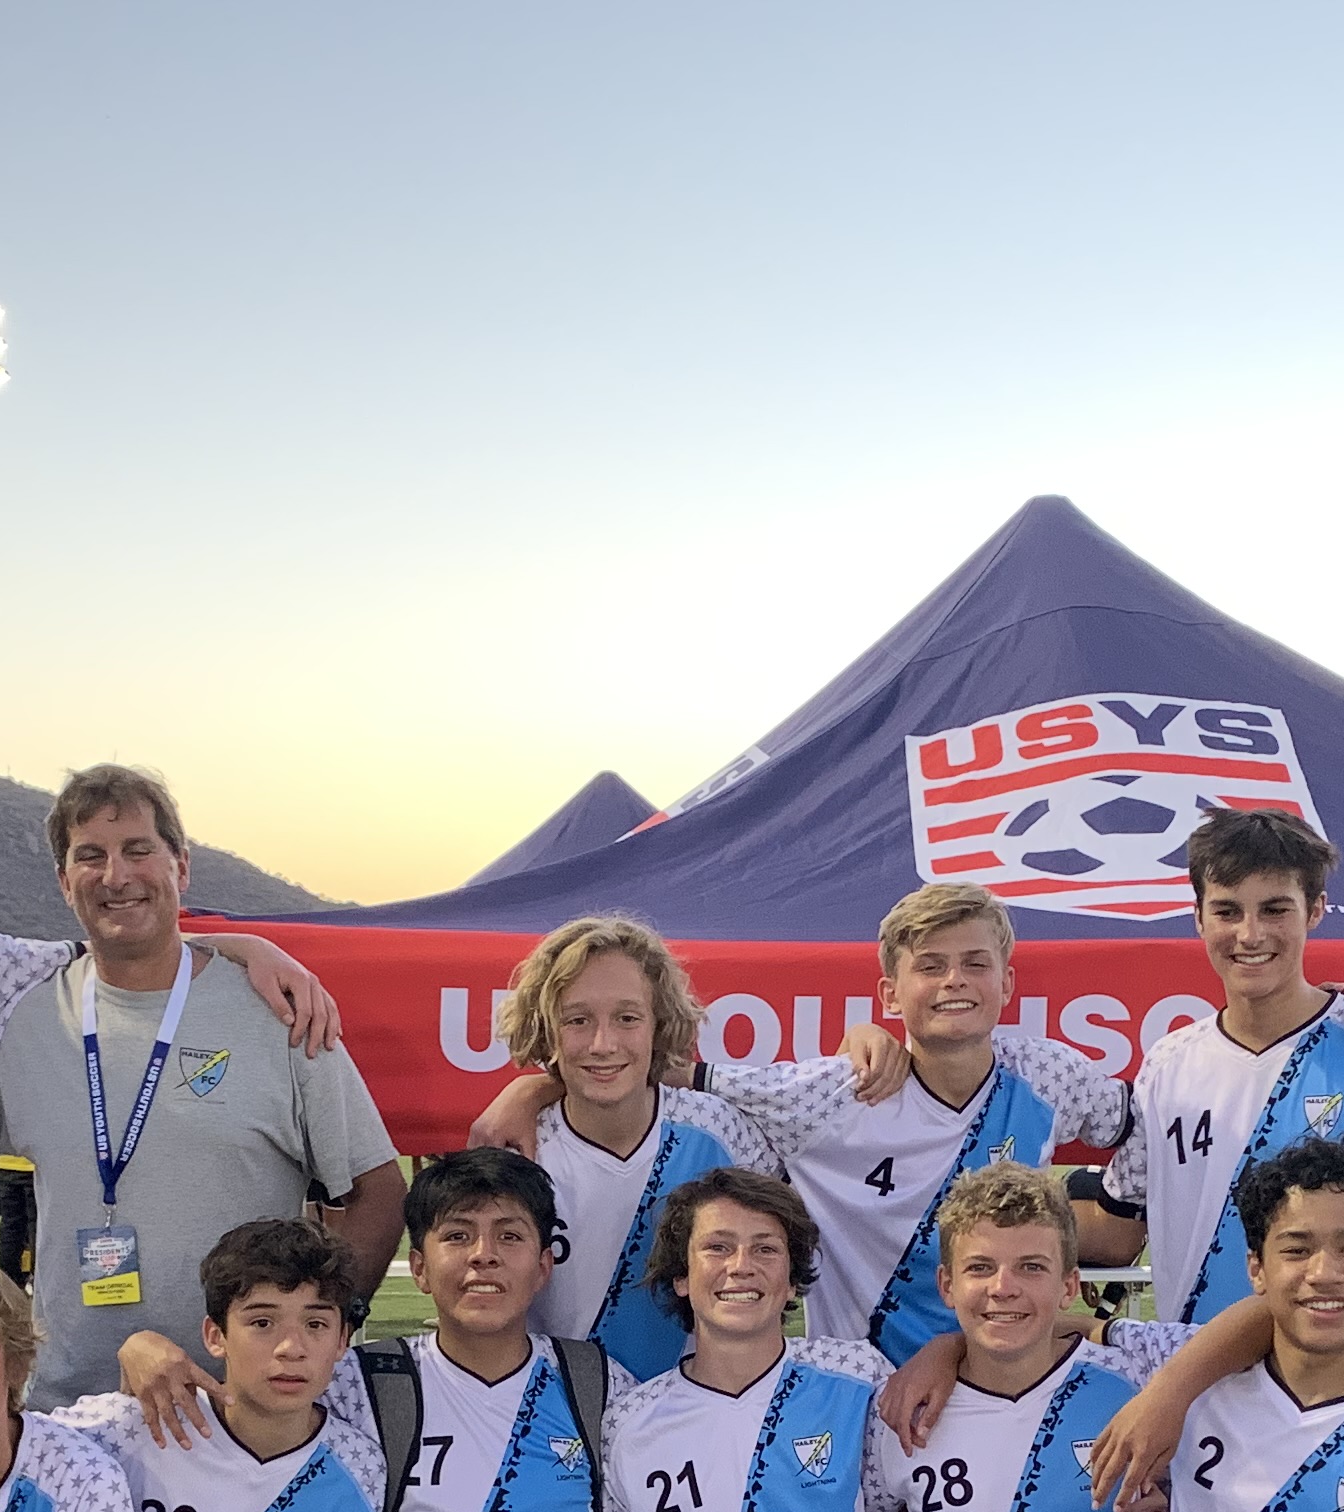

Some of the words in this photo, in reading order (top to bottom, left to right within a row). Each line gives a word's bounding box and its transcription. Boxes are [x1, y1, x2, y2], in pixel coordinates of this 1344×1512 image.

[919, 700, 1280, 780] USYS
[181, 1051, 209, 1060] HAILEY
[201, 1076, 216, 1085] FC
[1323, 1119, 1334, 1127] FC
[1167, 1109, 1213, 1164] 14
[865, 1157, 895, 1197] 4
[815, 1458, 828, 1467] FC
[1194, 1436, 1224, 1490] 2
[801, 1477, 837, 1488] LIGHTNING
